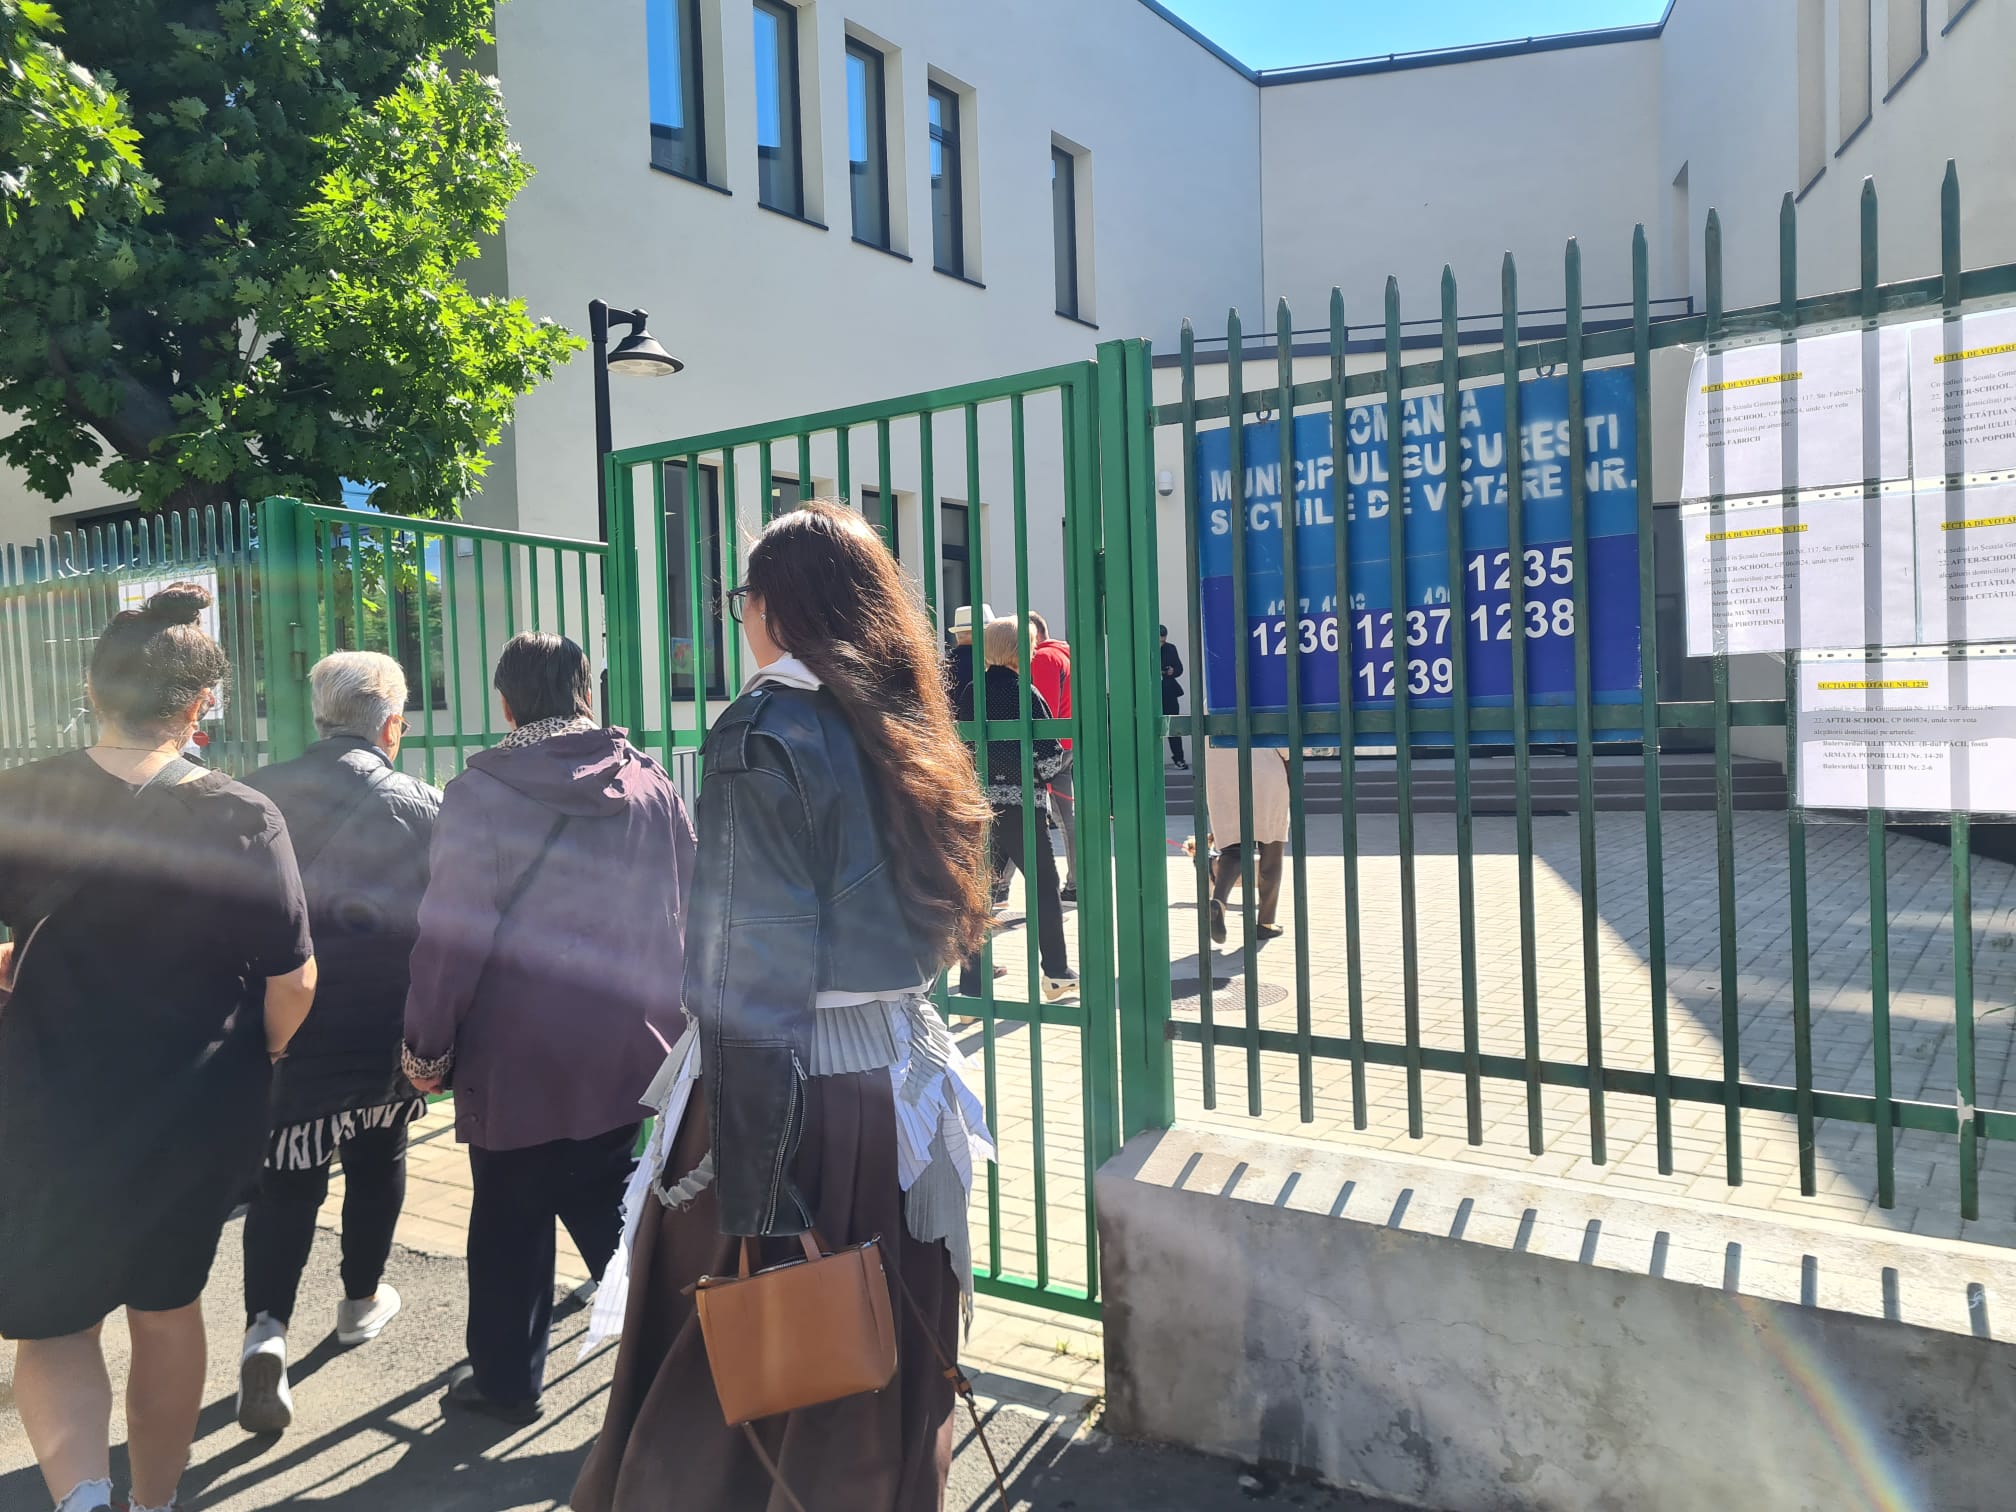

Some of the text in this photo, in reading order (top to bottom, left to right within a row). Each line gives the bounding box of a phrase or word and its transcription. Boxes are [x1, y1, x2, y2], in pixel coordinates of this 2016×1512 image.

[1739, 376, 1771, 387] VOTARE
[1329, 390, 1481, 448] OMANA
[1211, 450, 1389, 502] MNICIPUL
[1744, 528, 1776, 537] VOTARE
[1468, 546, 1574, 591] 1235
[1252, 617, 1339, 656] 1236
[1357, 608, 1451, 649] 1237
[1470, 599, 1575, 642] 1238
[1359, 657, 1453, 697] 1239
[1848, 681, 1858, 689] DE
[1861, 681, 1893, 689] VOTARE
